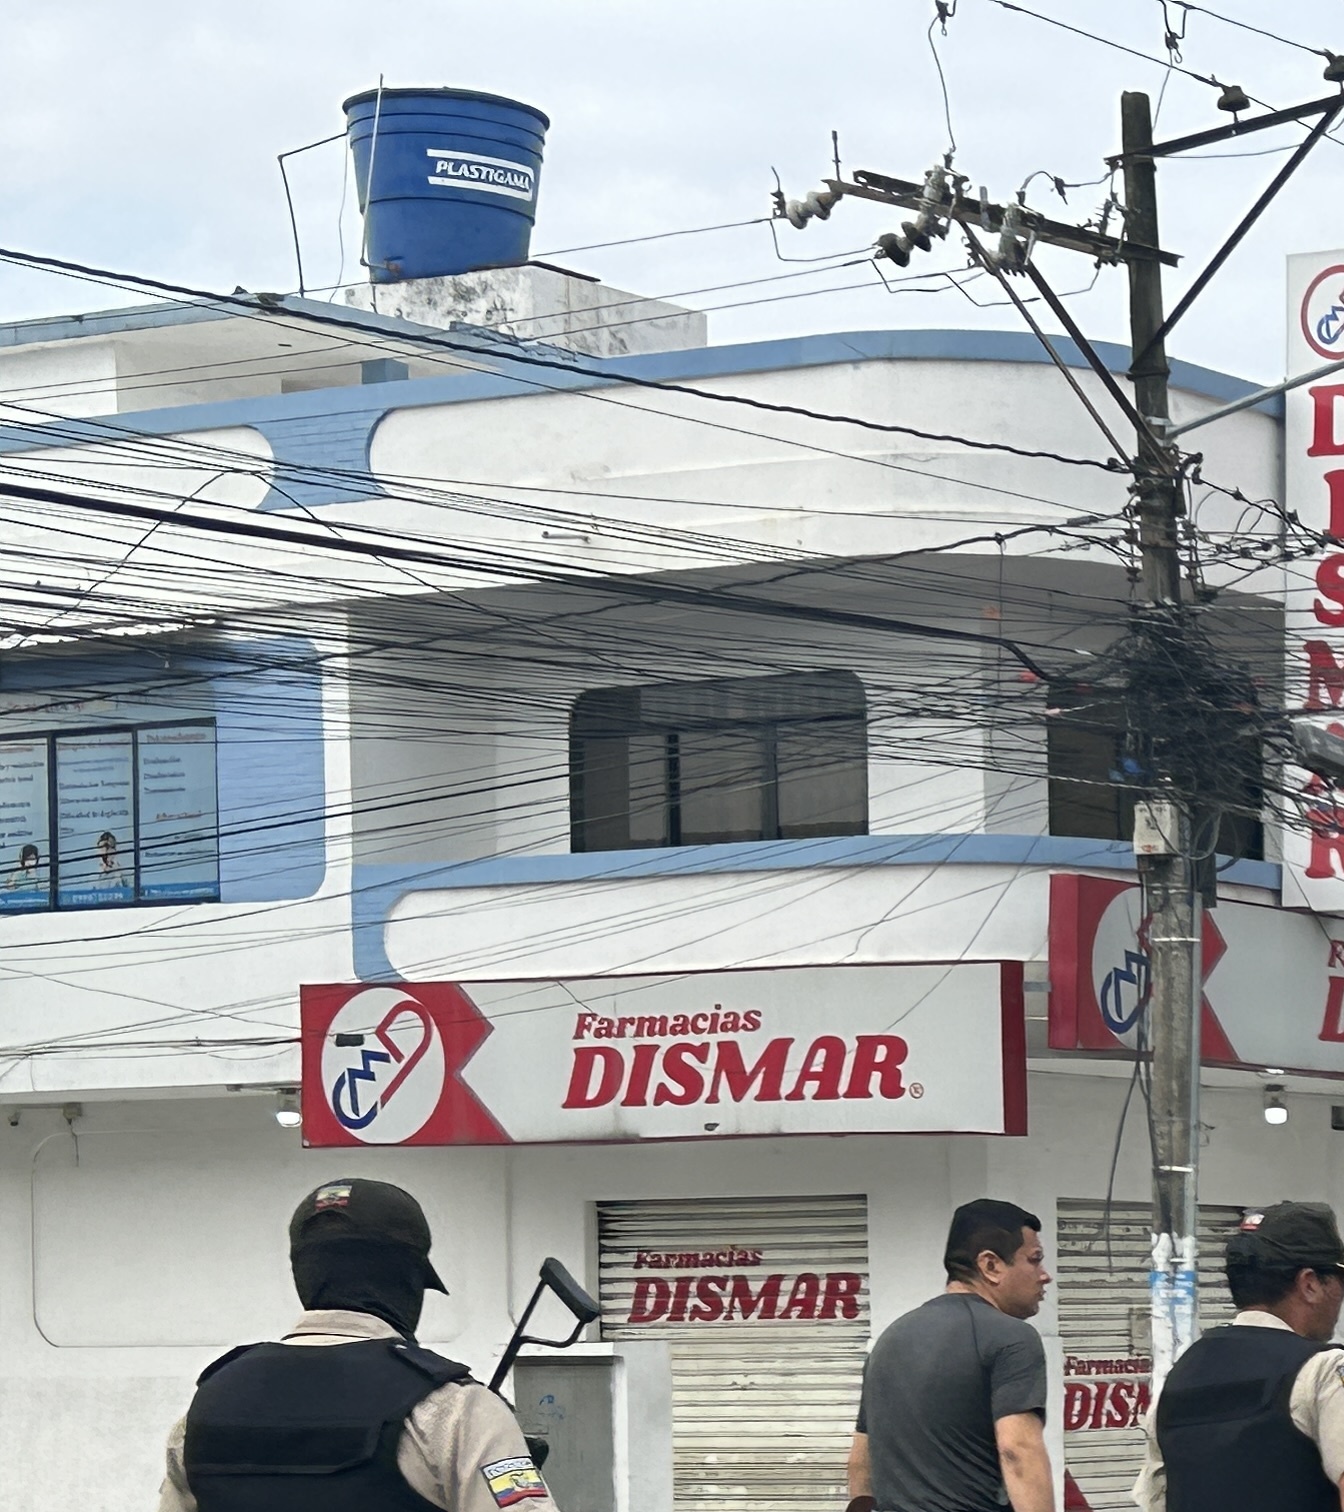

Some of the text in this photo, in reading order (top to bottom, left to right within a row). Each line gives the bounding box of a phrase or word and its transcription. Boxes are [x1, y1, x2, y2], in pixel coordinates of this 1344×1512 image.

[573, 1004, 762, 1040] Farmacias
[561, 1035, 908, 1109] DISMAR
[633, 1245, 763, 1269] Farmacias
[628, 1272, 862, 1323] DISMAR
[1064, 1382, 1152, 1430] DIS
